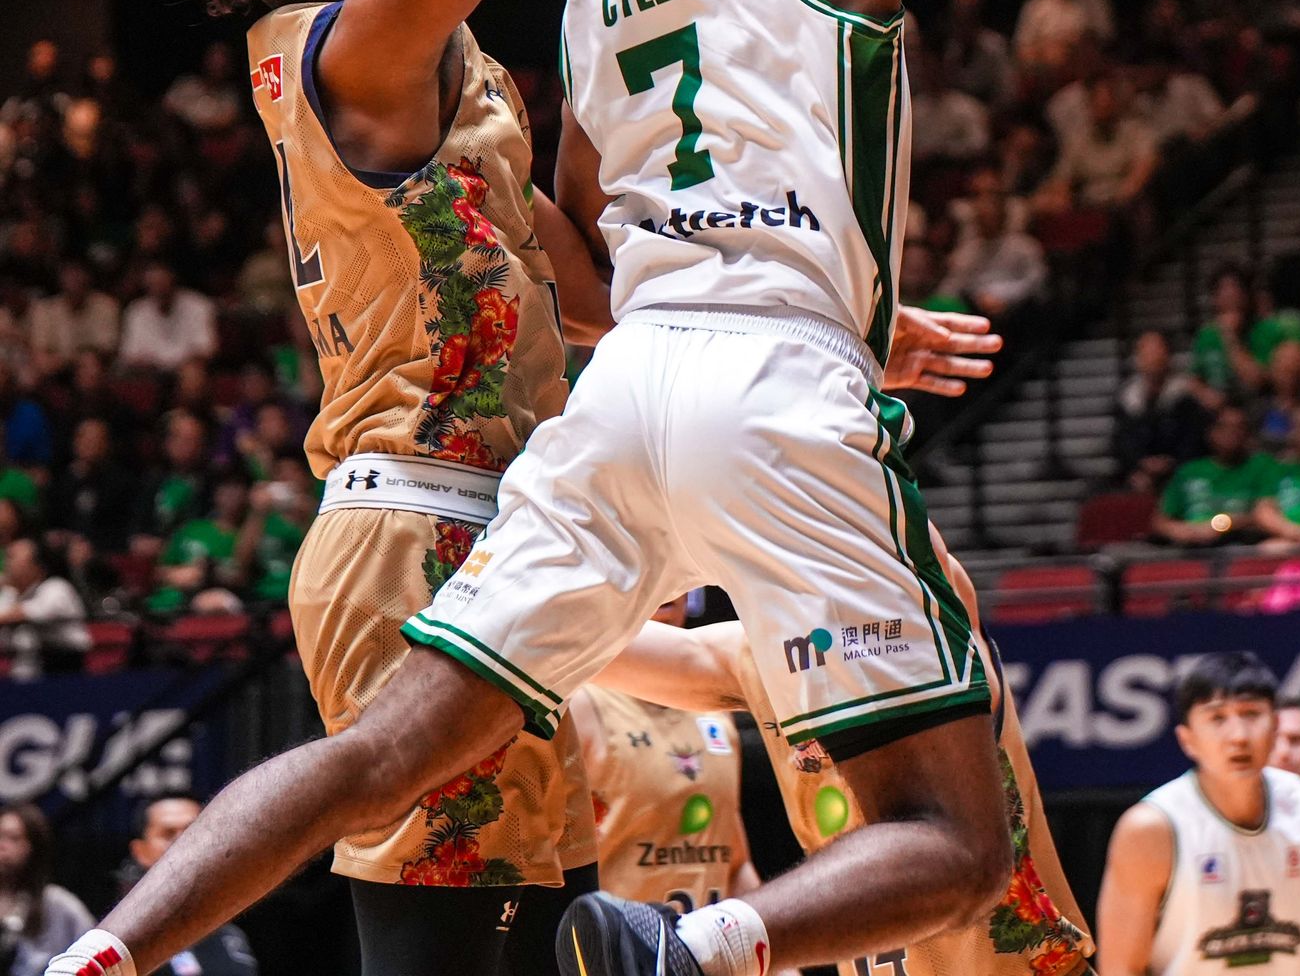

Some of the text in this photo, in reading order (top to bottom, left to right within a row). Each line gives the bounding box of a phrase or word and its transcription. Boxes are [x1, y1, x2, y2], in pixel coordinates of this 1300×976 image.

[616, 22, 715, 191] 7
[385, 476, 497, 504] NDER ARMOUR
[841, 618, 902, 648] 澳門通
[843, 641, 910, 662] MACAU Pass
